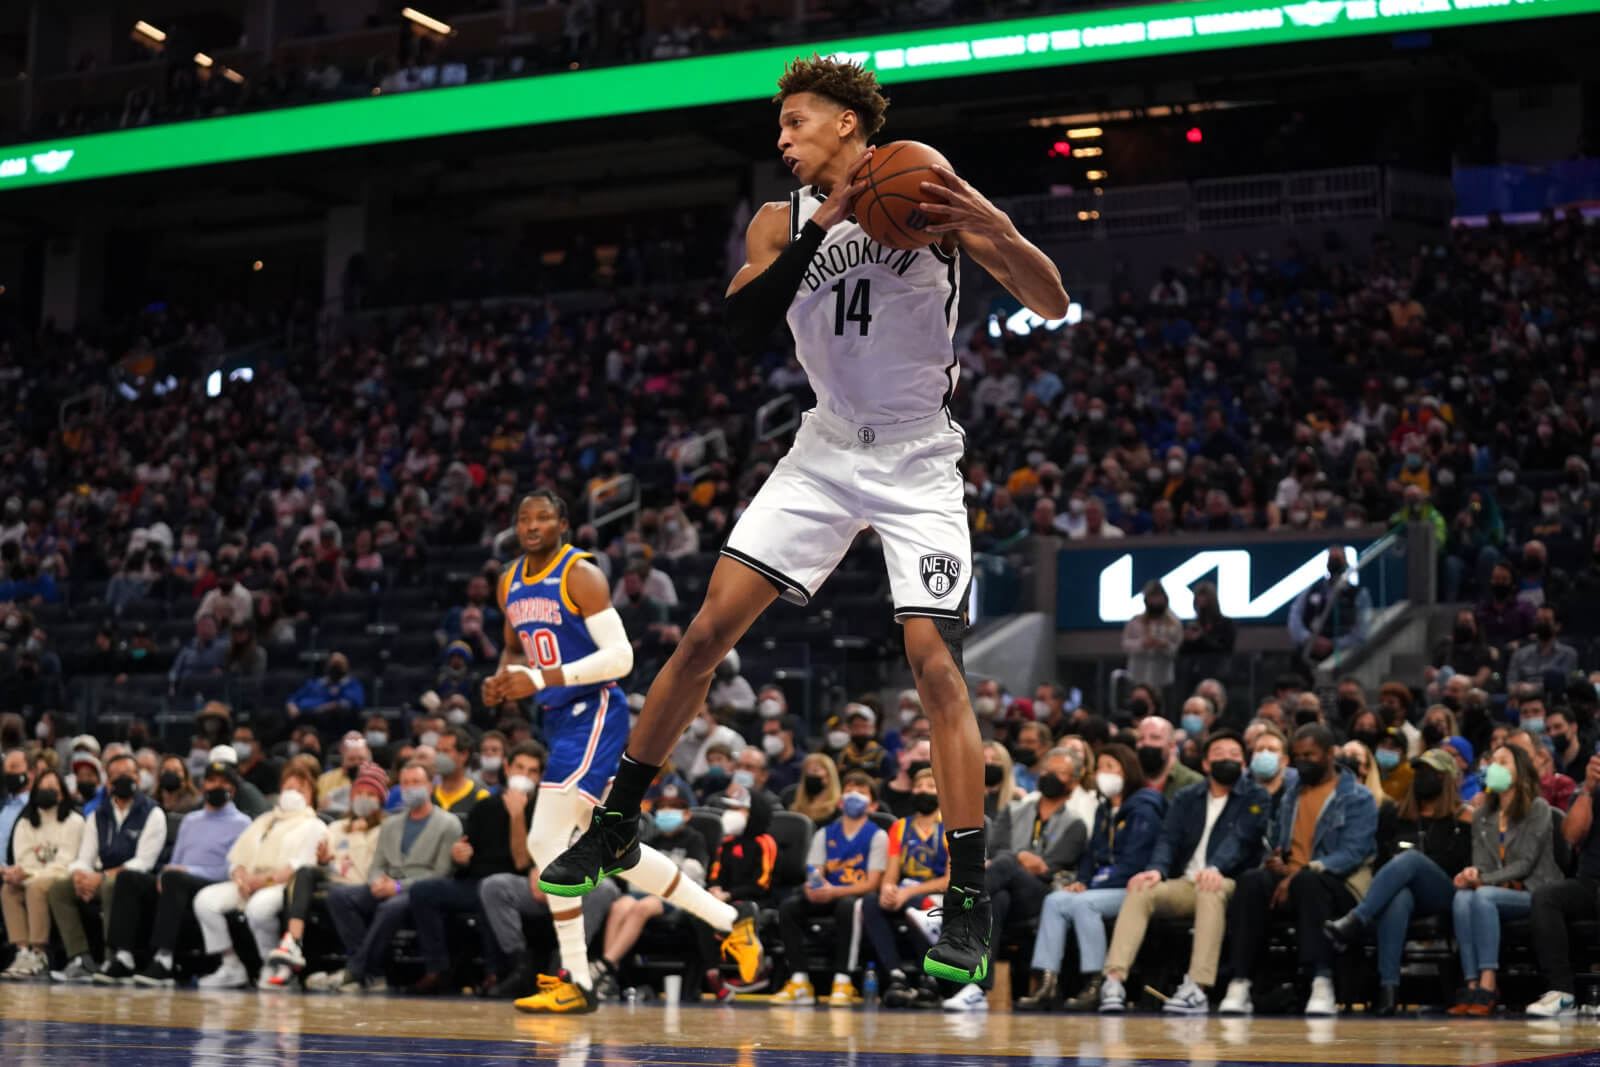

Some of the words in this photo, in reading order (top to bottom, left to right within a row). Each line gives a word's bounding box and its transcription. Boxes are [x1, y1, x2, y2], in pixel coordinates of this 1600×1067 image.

[831, 278, 872, 337] 14
[922, 556, 958, 577] NETS
[518, 628, 562, 670] 00
